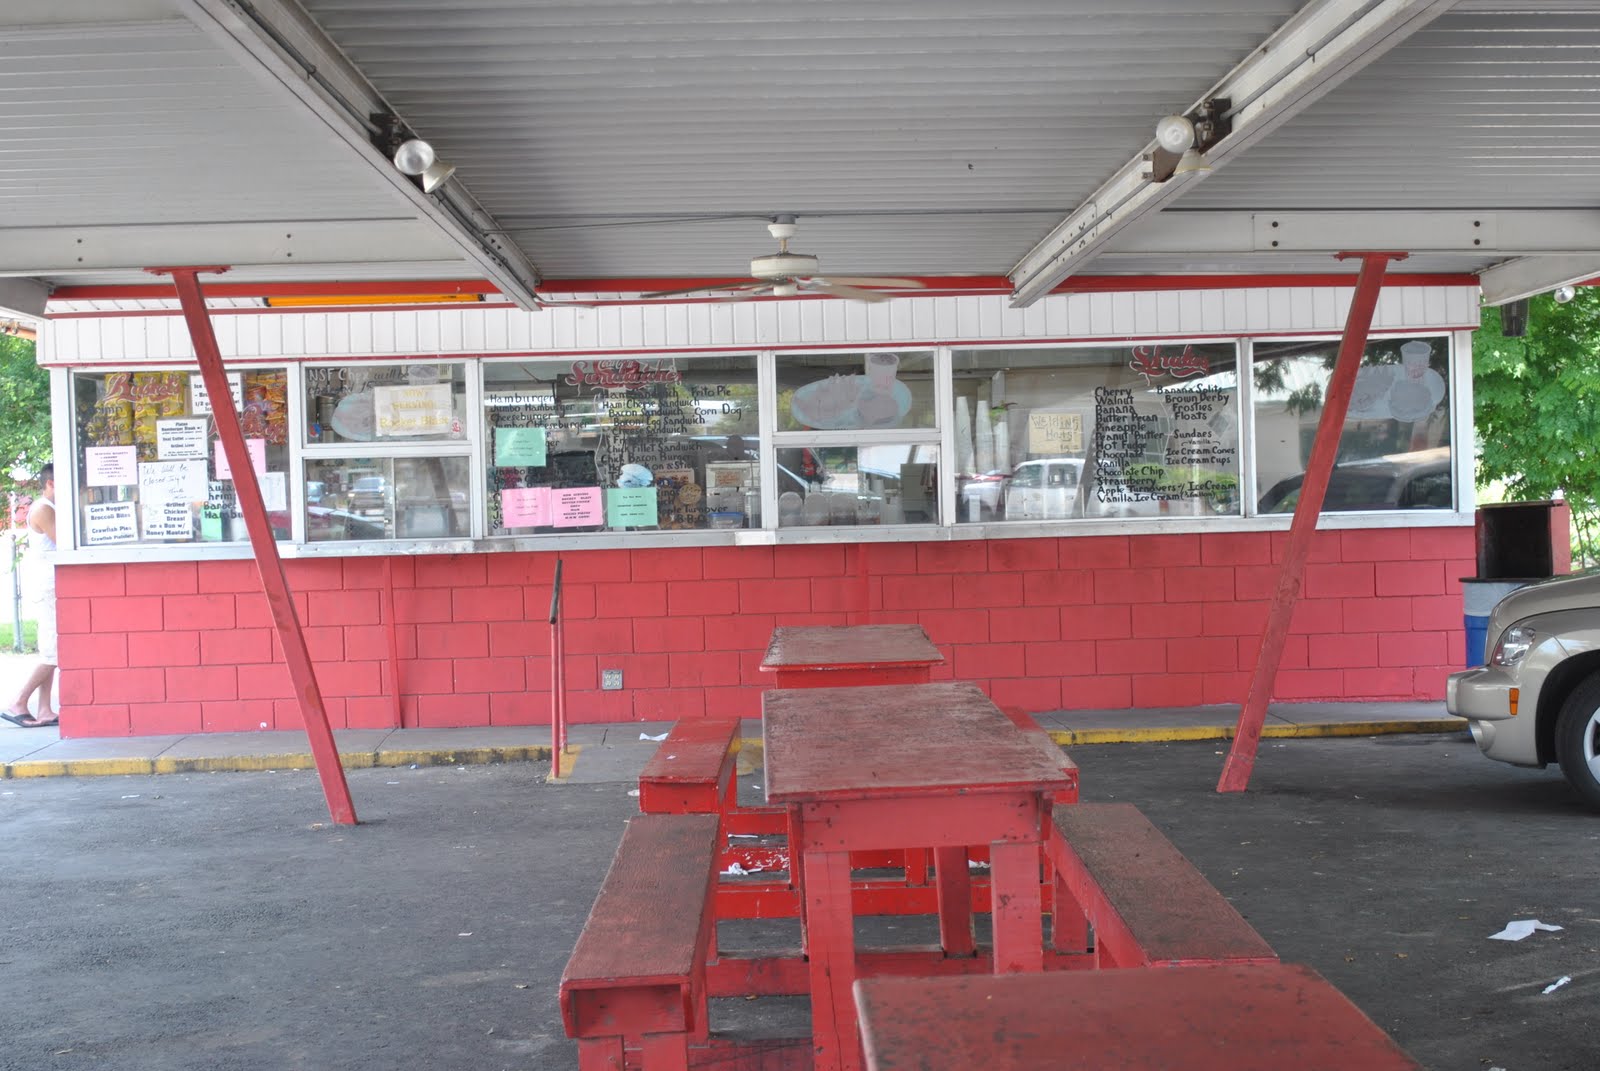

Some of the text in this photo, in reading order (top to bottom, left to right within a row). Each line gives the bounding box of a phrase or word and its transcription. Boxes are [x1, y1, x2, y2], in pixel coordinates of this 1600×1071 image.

[309, 368, 335, 381] NSF
[691, 385, 715, 398] Frito
[717, 385, 731, 396] Pie
[1095, 386, 1132, 400] Cherry
[1157, 385, 1193, 394] Banana
[490, 393, 555, 405] Hamburger
[1095, 396, 1134, 405] Walnut
[1165, 392, 1230, 406] Brown Derby
[490, 403, 575, 417] Jumbo Hamburger
[603, 402, 623, 410] Ham
[1096, 405, 1136, 414] Banana
[1172, 402, 1213, 411] Frosties
[491, 412, 552, 422] Cheeseburger
[609, 409, 638, 418] Bacon
[694, 408, 718, 416] Corn
[722, 403, 742, 421] Dog
[1174, 411, 1207, 420] Floats
[662, 414, 706, 426] Sandwich
[1096, 413, 1158, 423] Butter Pecan
[646, 425, 688, 436] Sandwich
[1096, 422, 1147, 434] Pineapple
[1173, 427, 1213, 439] Sundaes
[1096, 430, 1165, 440] Peanut Butter
[1096, 440, 1148, 450] Hot Fudge
[1096, 449, 1144, 459] Chocolate
[1166, 446, 1236, 456] Ice Cream Cones
[628, 452, 657, 462] Bacon
[1096, 457, 1131, 467] Vanilla
[1166, 456, 1231, 466] Ice Cream Cups
[1097, 466, 1164, 479] Chocolate Chip
[1097, 475, 1157, 487] Strawberry
[1097, 486, 1125, 497] Apple
[1126, 483, 1176, 493] Turnovers
[1187, 481, 1203, 491] Ice
[1204, 480, 1237, 491] Cream
[1097, 493, 1133, 503] Vanilla
[1134, 493, 1150, 502] Ice
[1151, 491, 1180, 501] Cream
[684, 503, 728, 514] Turnover
